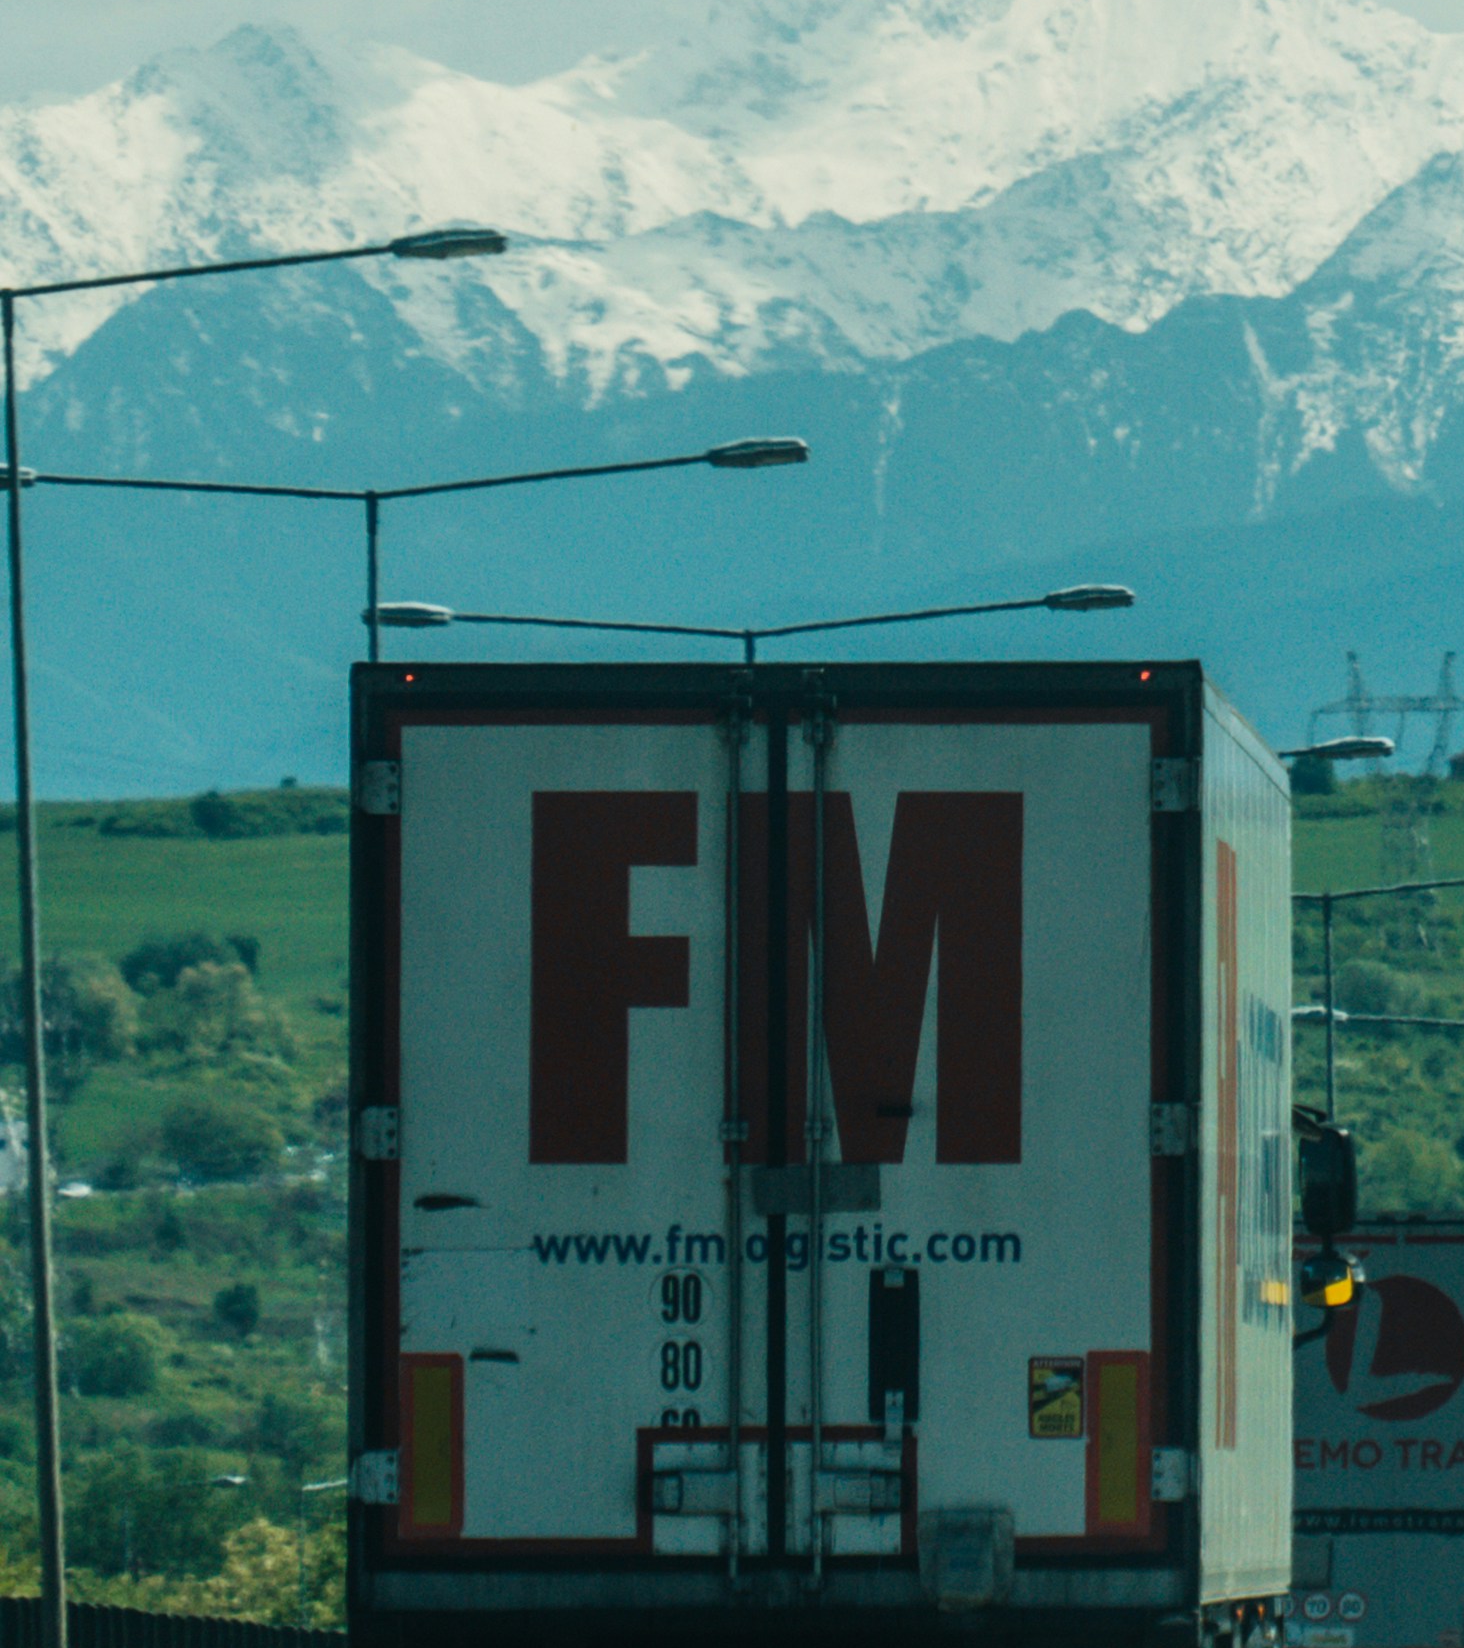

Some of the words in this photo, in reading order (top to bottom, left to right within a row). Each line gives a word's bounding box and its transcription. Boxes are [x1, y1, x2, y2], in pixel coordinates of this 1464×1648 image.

[529, 791, 1023, 1163] FM
[534, 1224, 1021, 1270] www.fmogistic.com
[661, 1274, 702, 1323] 90
[661, 1341, 702, 1391] 80
